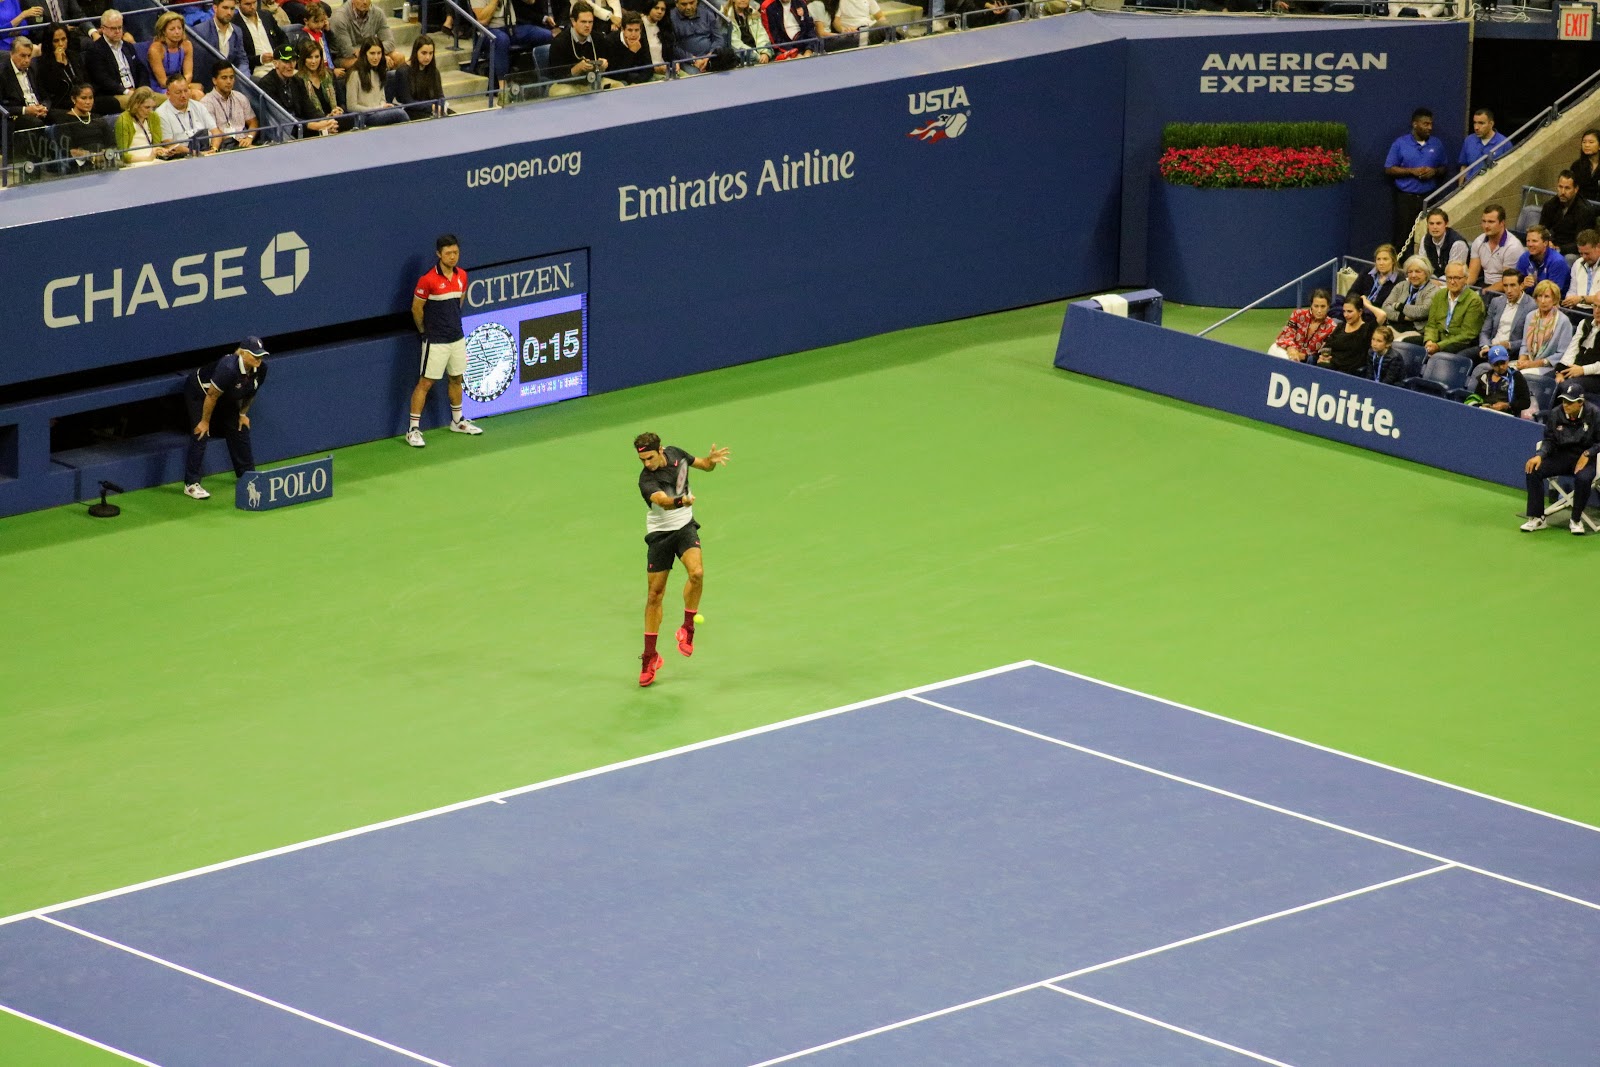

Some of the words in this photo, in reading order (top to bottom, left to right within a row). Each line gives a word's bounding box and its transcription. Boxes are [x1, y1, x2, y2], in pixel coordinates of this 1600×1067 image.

[1565, 13, 1589, 37] EXIT
[1202, 52, 1388, 72] AMERICAN
[908, 85, 971, 115] USTA
[1200, 75, 1356, 94] EXPRESS
[466, 150, 583, 189] usopen.org
[618, 172, 748, 222] Emirates
[757, 150, 855, 197] Airline
[43, 246, 248, 330] CHASE
[467, 262, 572, 309] CITIZEN
[522, 328, 580, 367] 0:15
[1266, 372, 1401, 439] Deloitte.
[269, 467, 327, 502] POLO
